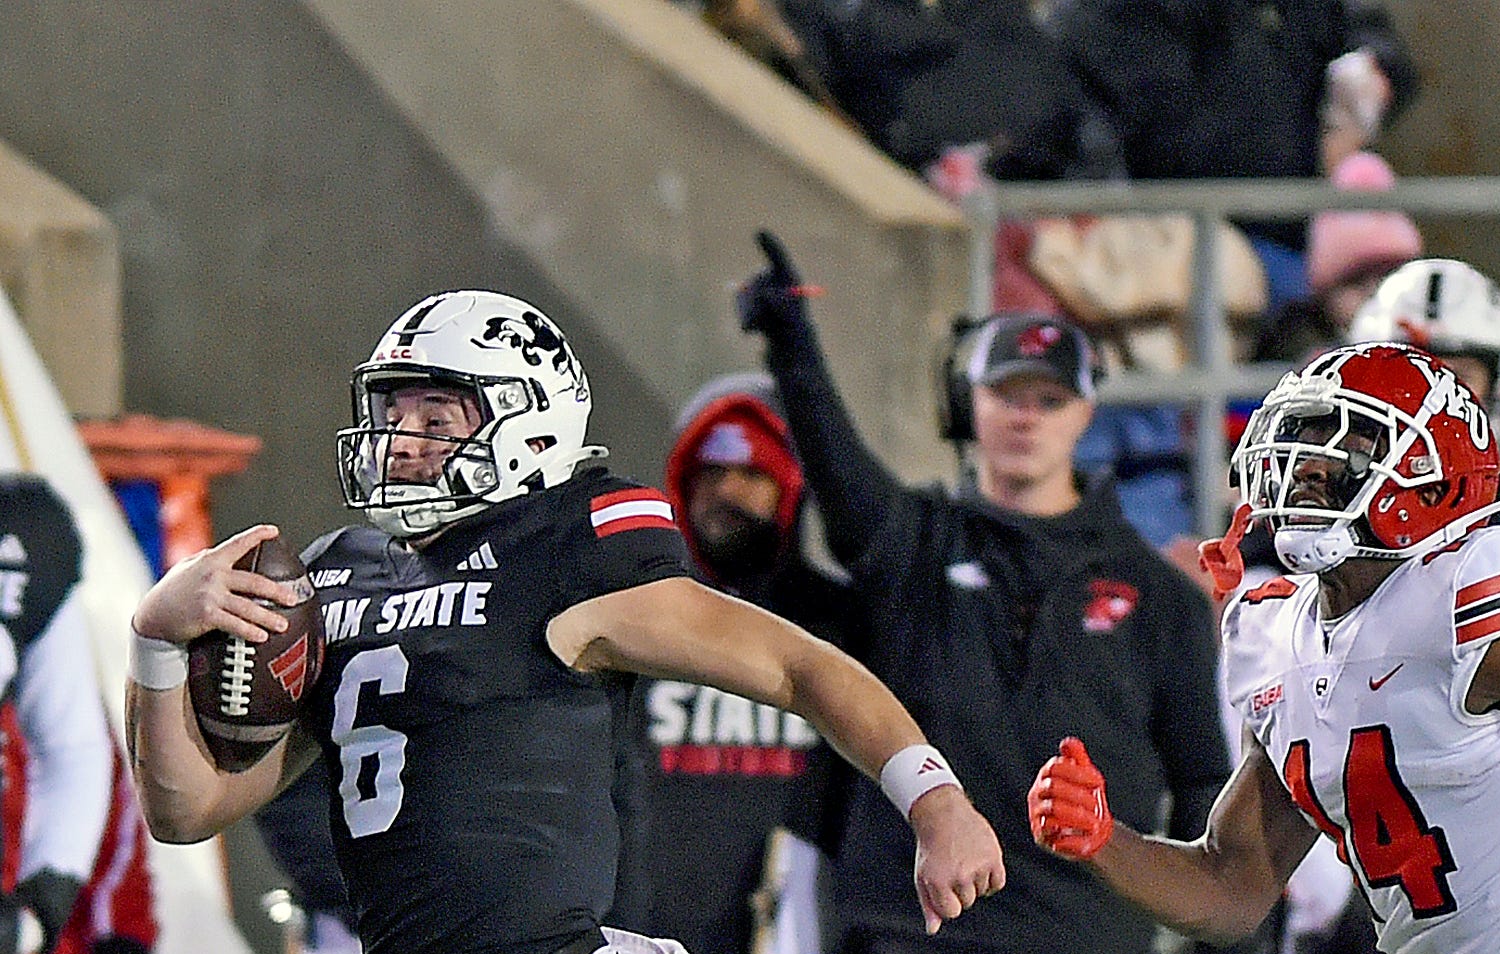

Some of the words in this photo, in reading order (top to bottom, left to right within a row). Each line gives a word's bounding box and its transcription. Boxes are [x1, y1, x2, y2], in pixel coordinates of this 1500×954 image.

[308, 567, 353, 589] USA
[321, 597, 372, 645] AX
[375, 581, 493, 635] STATE
[333, 643, 410, 839] 6
[1282, 722, 1459, 920] 14
